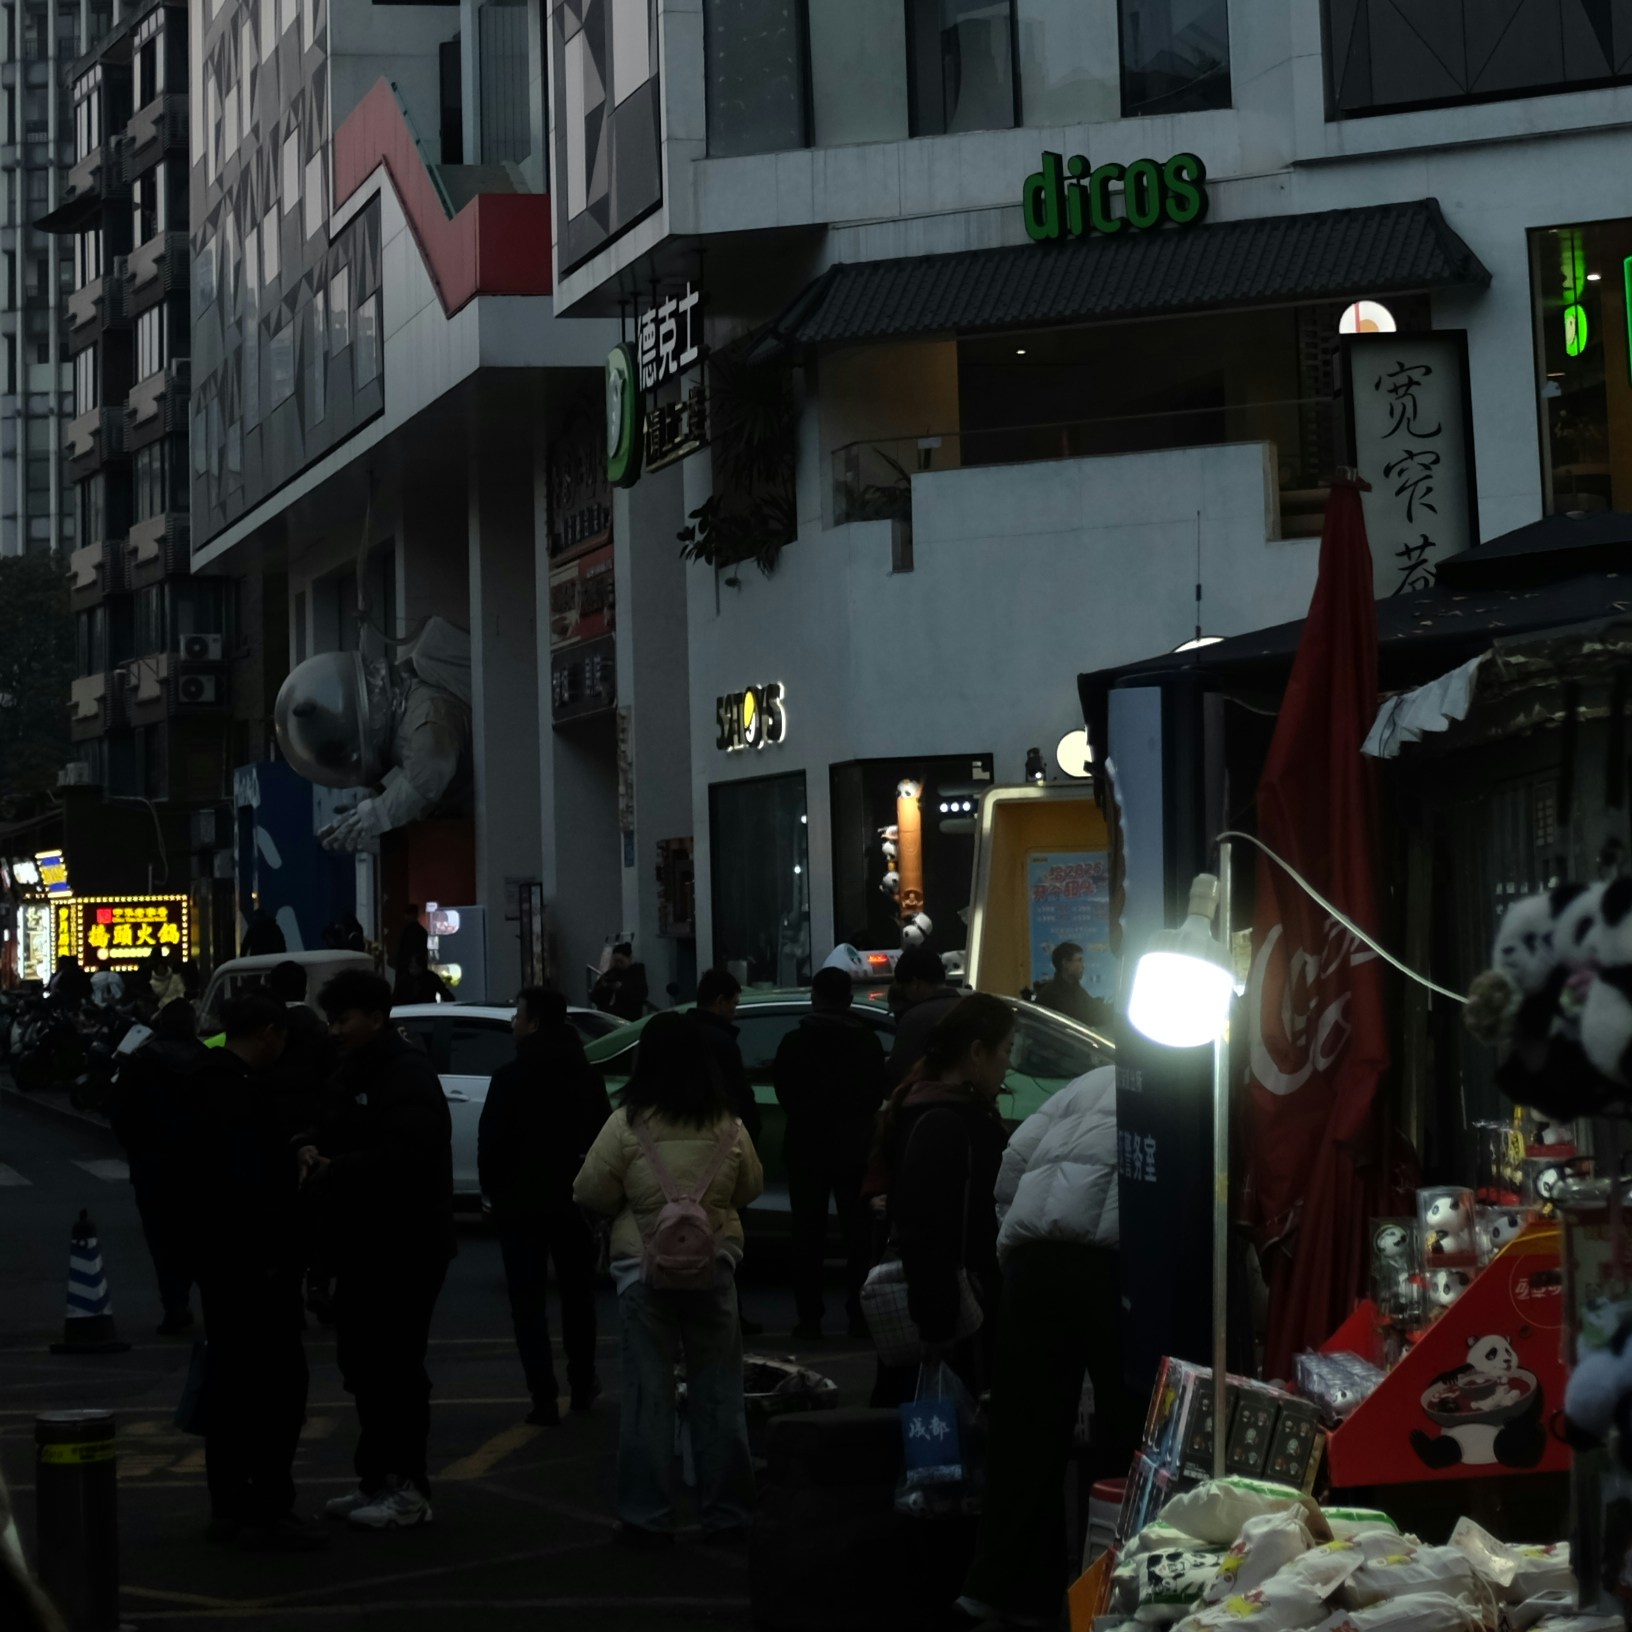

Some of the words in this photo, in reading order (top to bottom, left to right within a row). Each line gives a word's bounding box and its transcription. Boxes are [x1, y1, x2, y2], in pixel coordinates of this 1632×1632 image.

[1024, 151, 1209, 243] dicos
[637, 281, 700, 391] 德克士
[716, 680, 787, 752] 52TOYS
[908, 1414, 951, 1442] 成都
